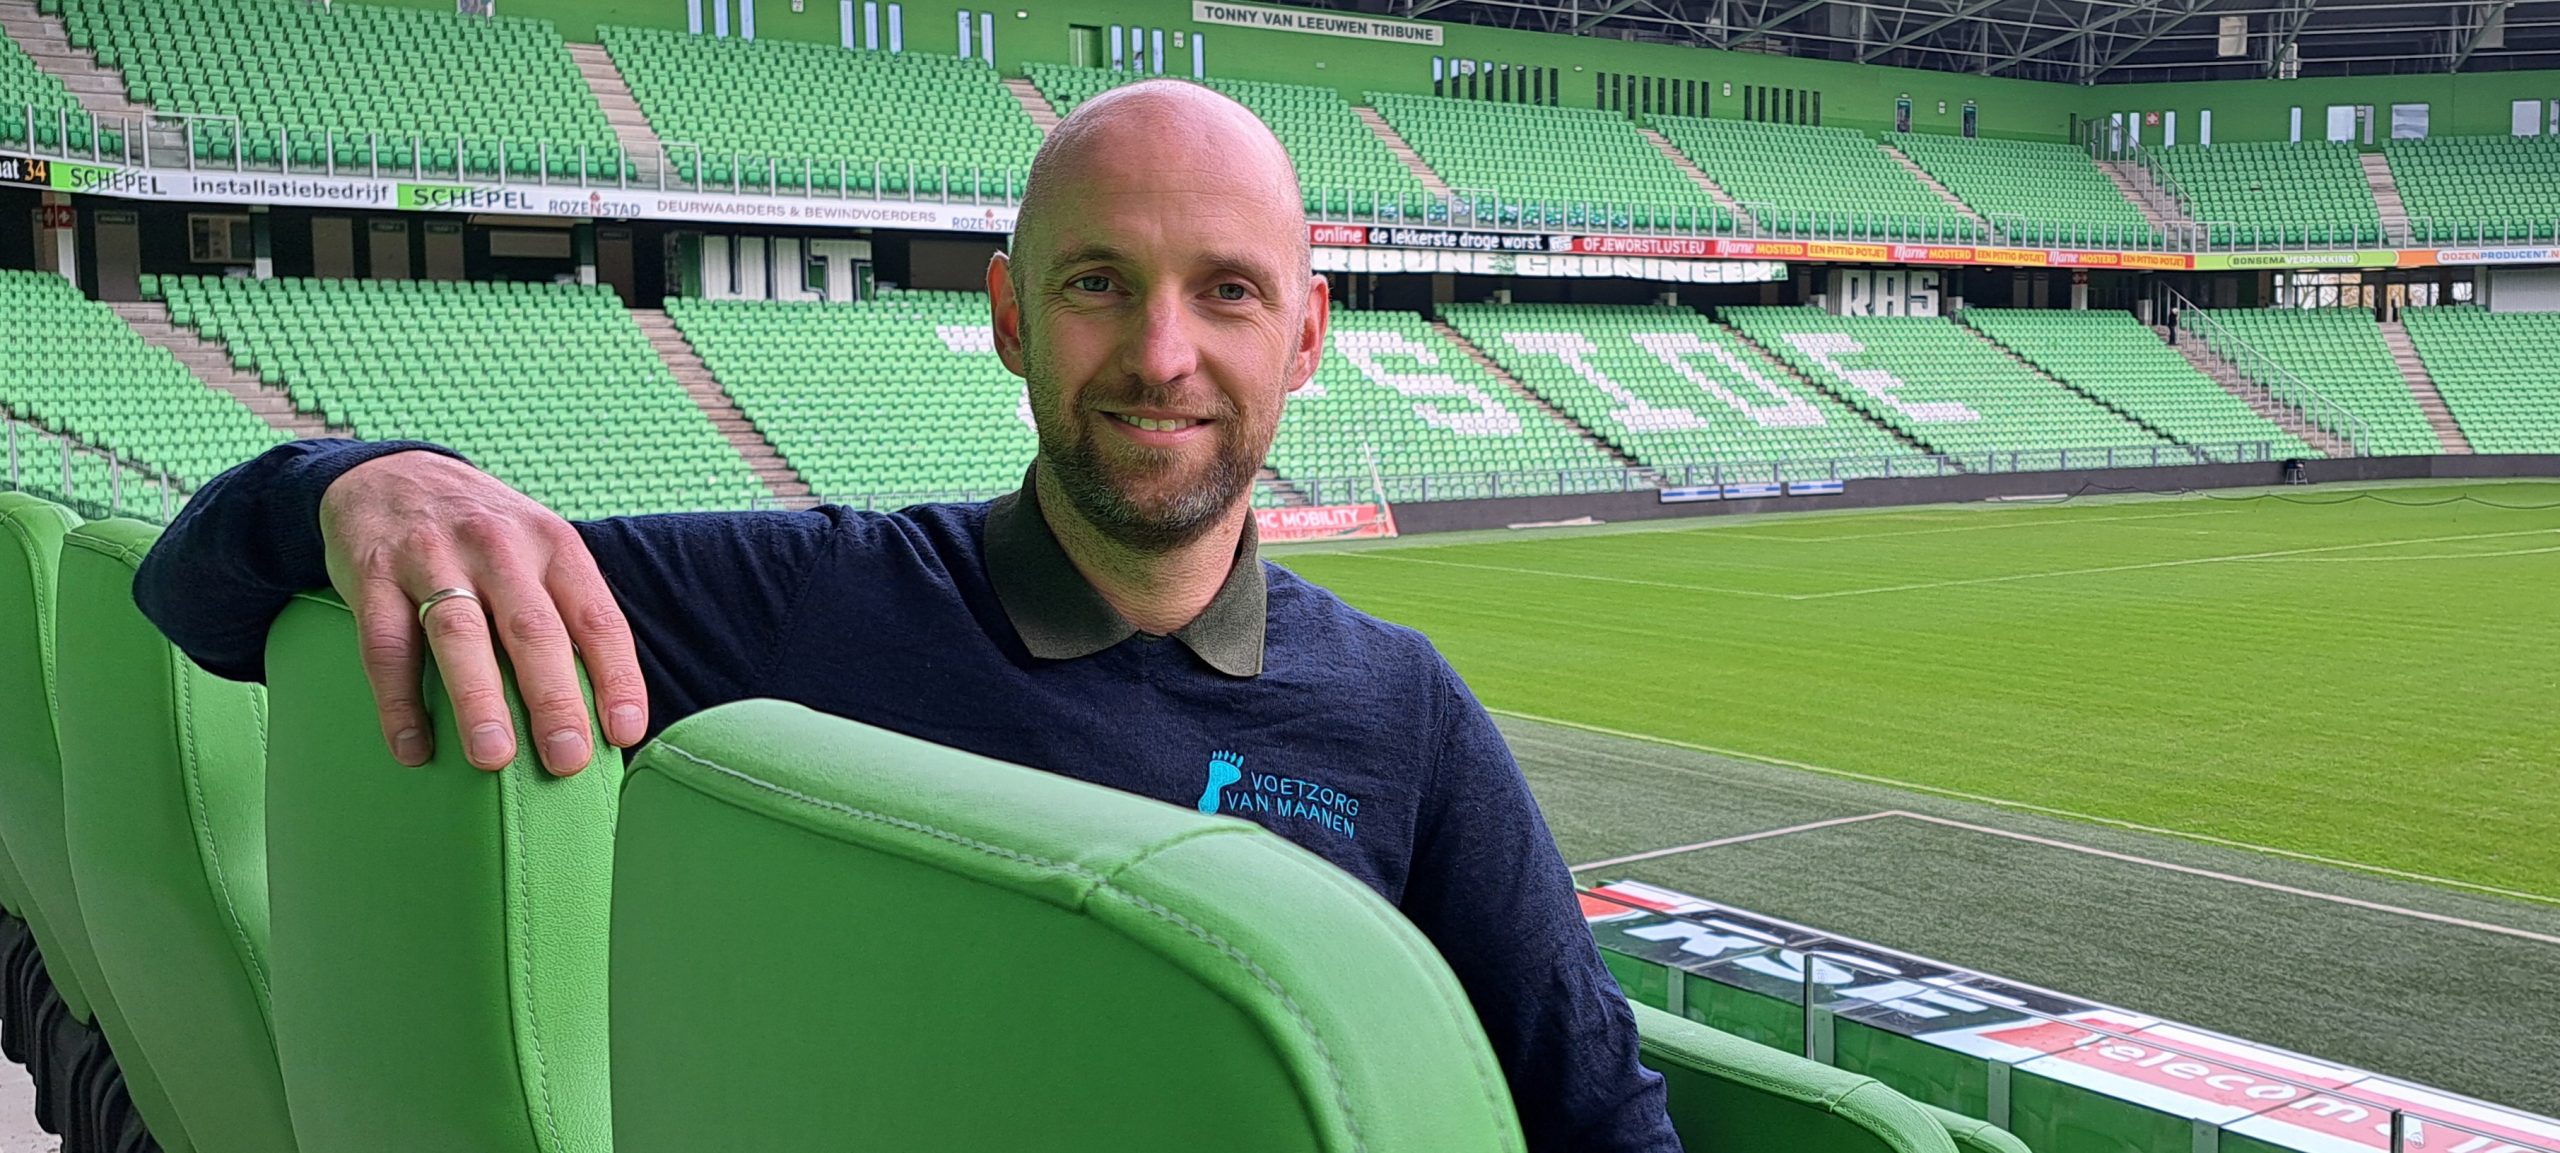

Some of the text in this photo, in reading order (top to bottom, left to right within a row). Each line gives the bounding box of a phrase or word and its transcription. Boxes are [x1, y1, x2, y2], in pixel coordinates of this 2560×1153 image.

[1204, 6, 1434, 41] TONNY VAN LEEUWEN TRIBUNE
[0, 158, 47, 183] at 34
[70, 167, 390, 204] SCHEPEL installatiebedrijf
[413, 188, 534, 210] SCHEPEL
[549, 200, 641, 217] ROZENSTAD
[657, 199, 936, 222] DEURWAARDERS & BEWINDVOERDERS
[952, 217, 1016, 231] ROZENST
[1313, 226, 1363, 243] online
[1369, 228, 1388, 244] de
[1391, 229, 1457, 247] lekkerste
[1460, 232, 1500, 250] droge
[1502, 235, 1543, 250] worst
[1582, 238, 1706, 255] OFJEWORSTLUST.EU
[1756, 243, 1803, 255] MOSTERD
[1312, 248, 1503, 276] RIBUNE
[1929, 249, 1972, 260] MOSTERD
[703, 235, 872, 301] ULT
[1841, 269, 1940, 316] RAS
[1281, 509, 1360, 528] MOBILITY
[1251, 771, 1359, 816] VOETZORG
[1226, 790, 1355, 839] VAN MAANEN
[2073, 1031, 2369, 1125] telecom
